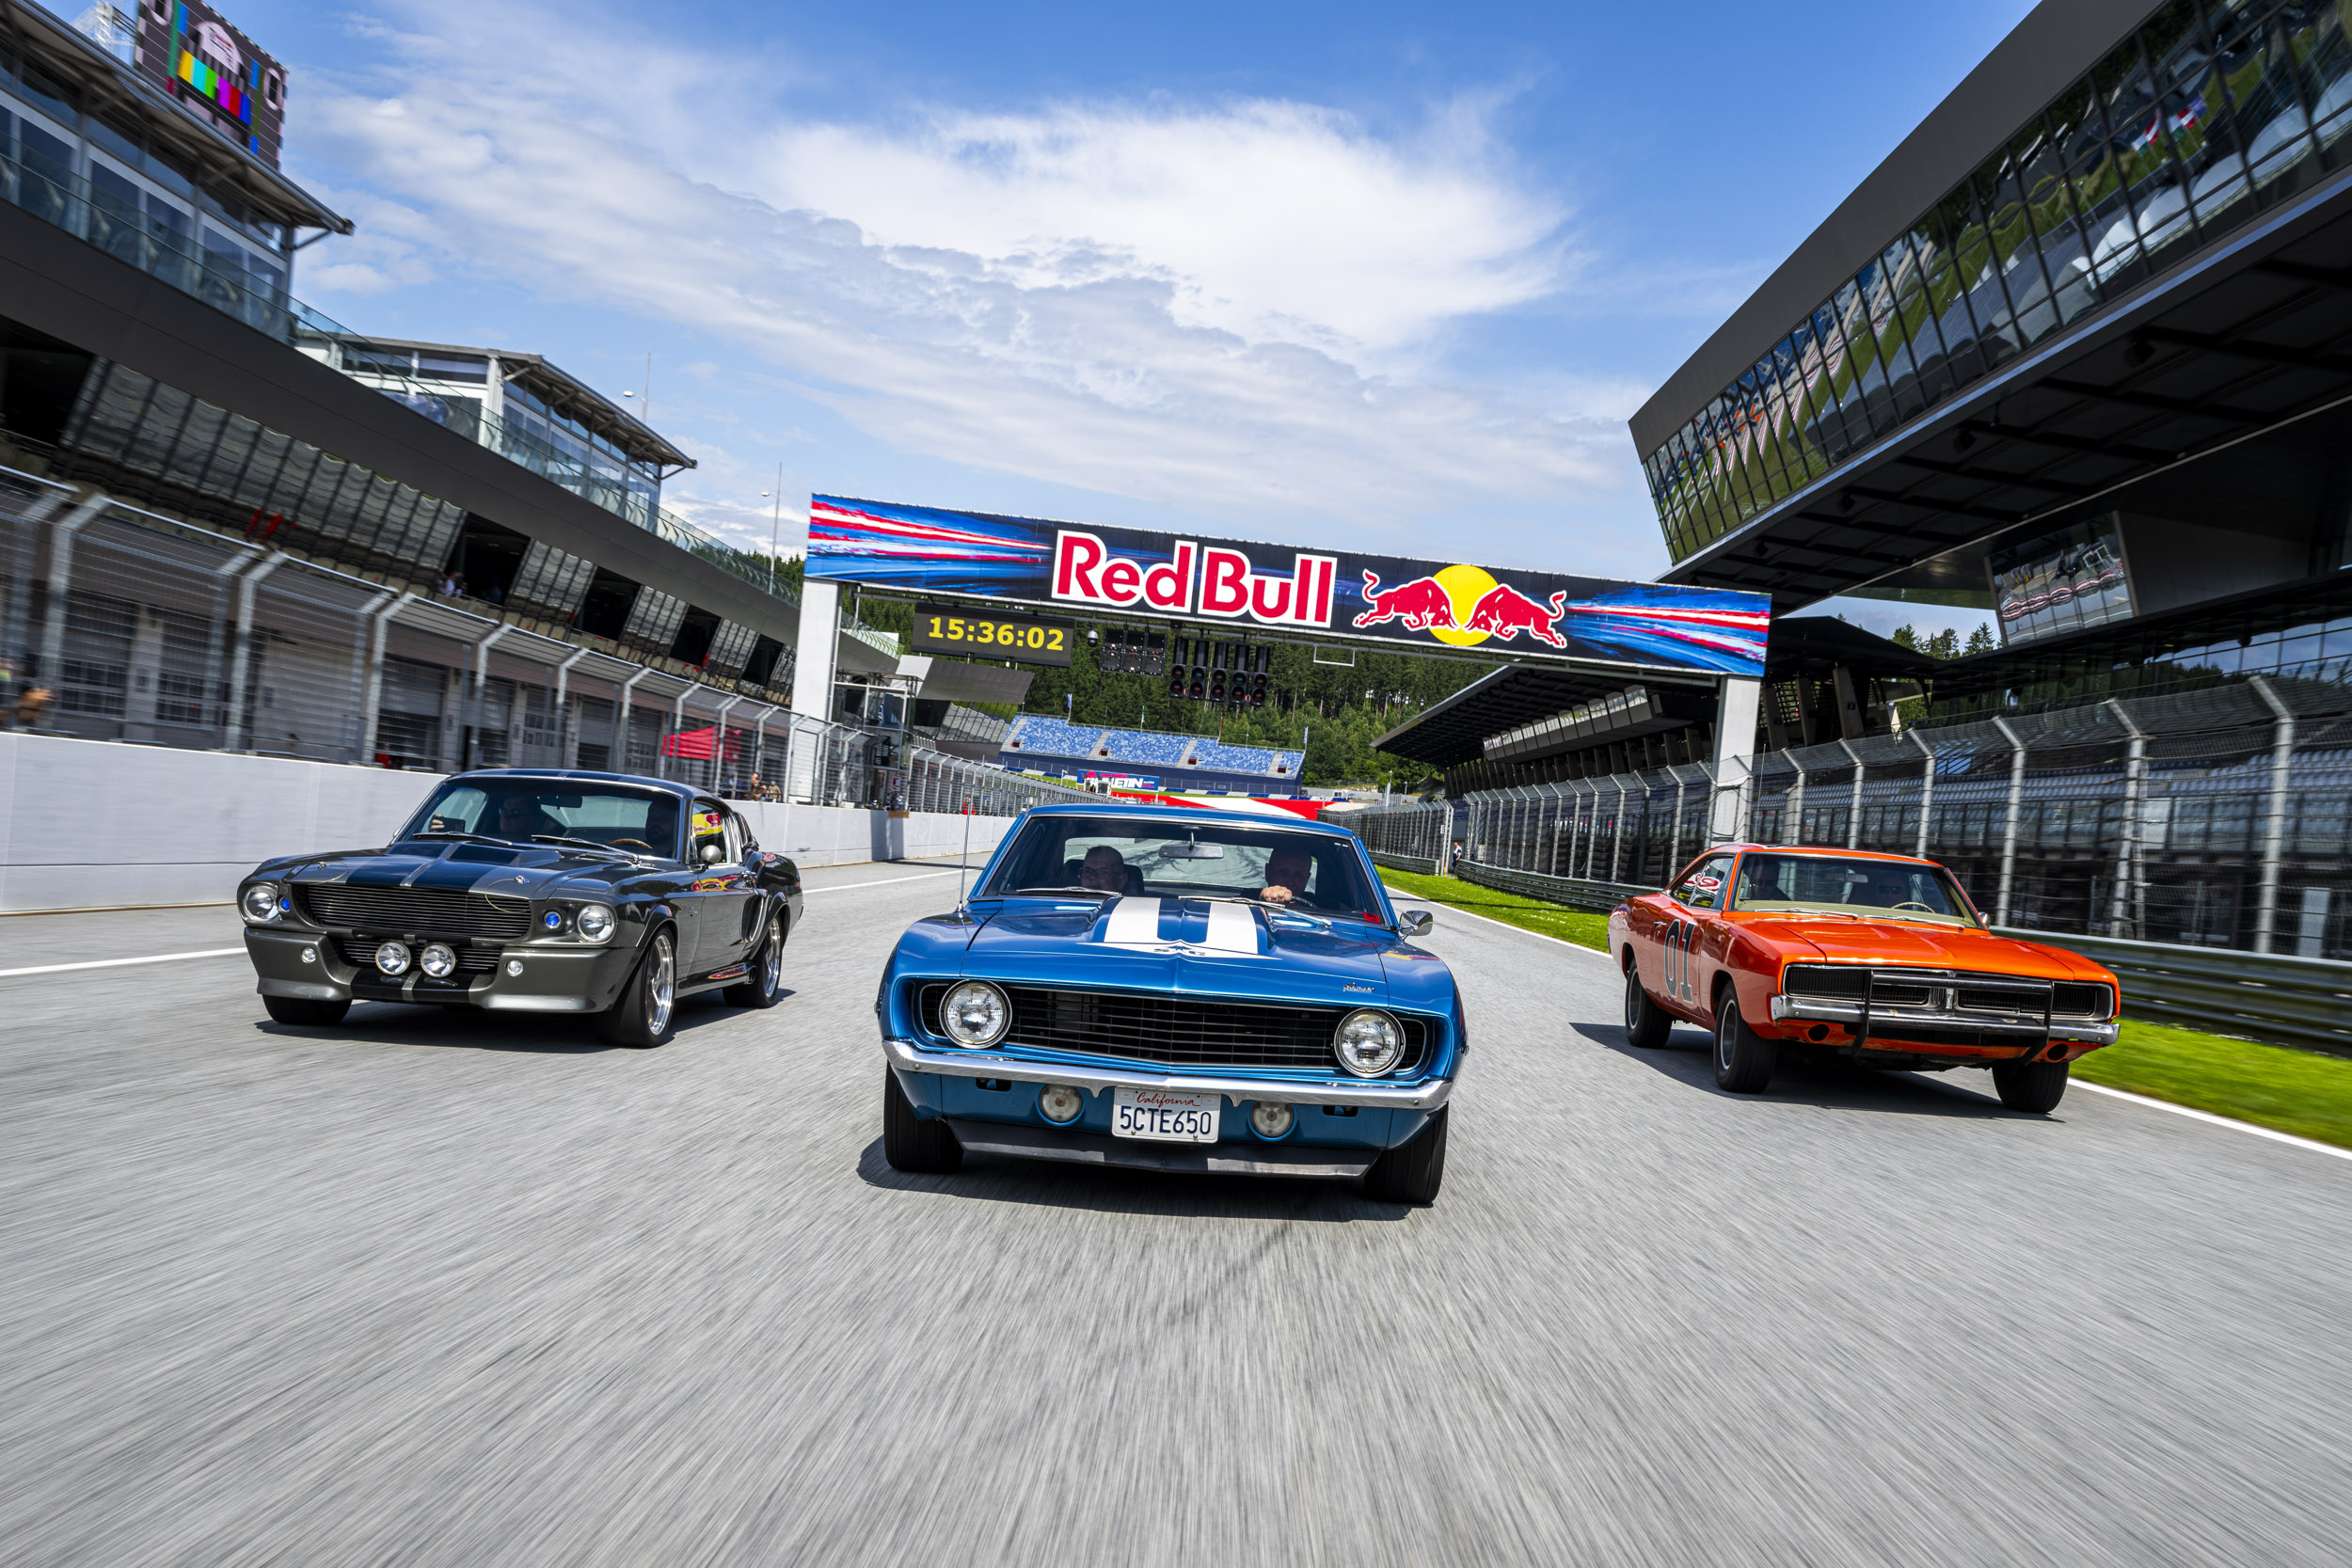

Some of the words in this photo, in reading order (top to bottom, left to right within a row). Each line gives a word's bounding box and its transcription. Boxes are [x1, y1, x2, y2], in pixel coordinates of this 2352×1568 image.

[1052, 531, 1197, 612] Red
[1198, 546, 1337, 628] Bull
[929, 617, 1064, 651] 15:36:02
[1664, 919, 1697, 1004] 01
[1136, 1091, 1200, 1108] California
[1120, 1105, 1212, 1134] 5CTE650
